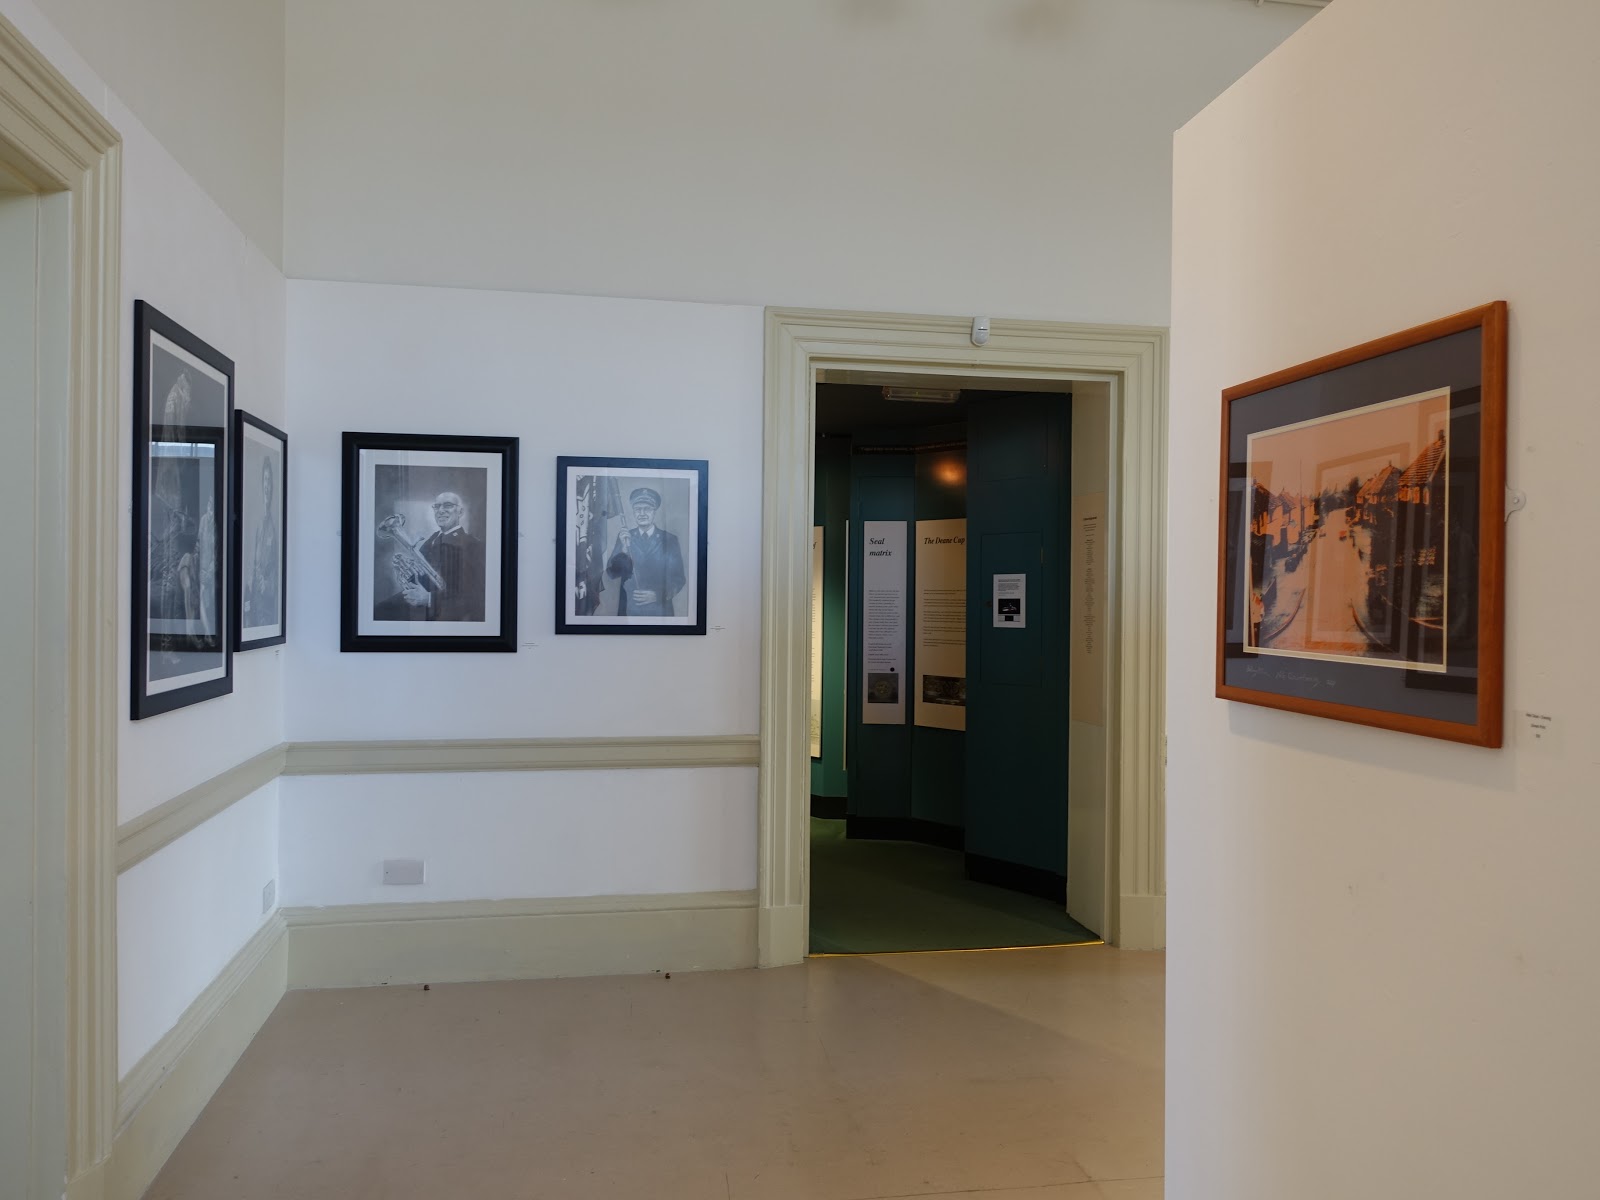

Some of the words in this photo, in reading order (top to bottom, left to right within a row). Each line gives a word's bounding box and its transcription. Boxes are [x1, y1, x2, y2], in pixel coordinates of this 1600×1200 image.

[869, 537, 885, 545] Seal
[924, 537, 934, 545] The
[953, 536, 965, 545] Cup
